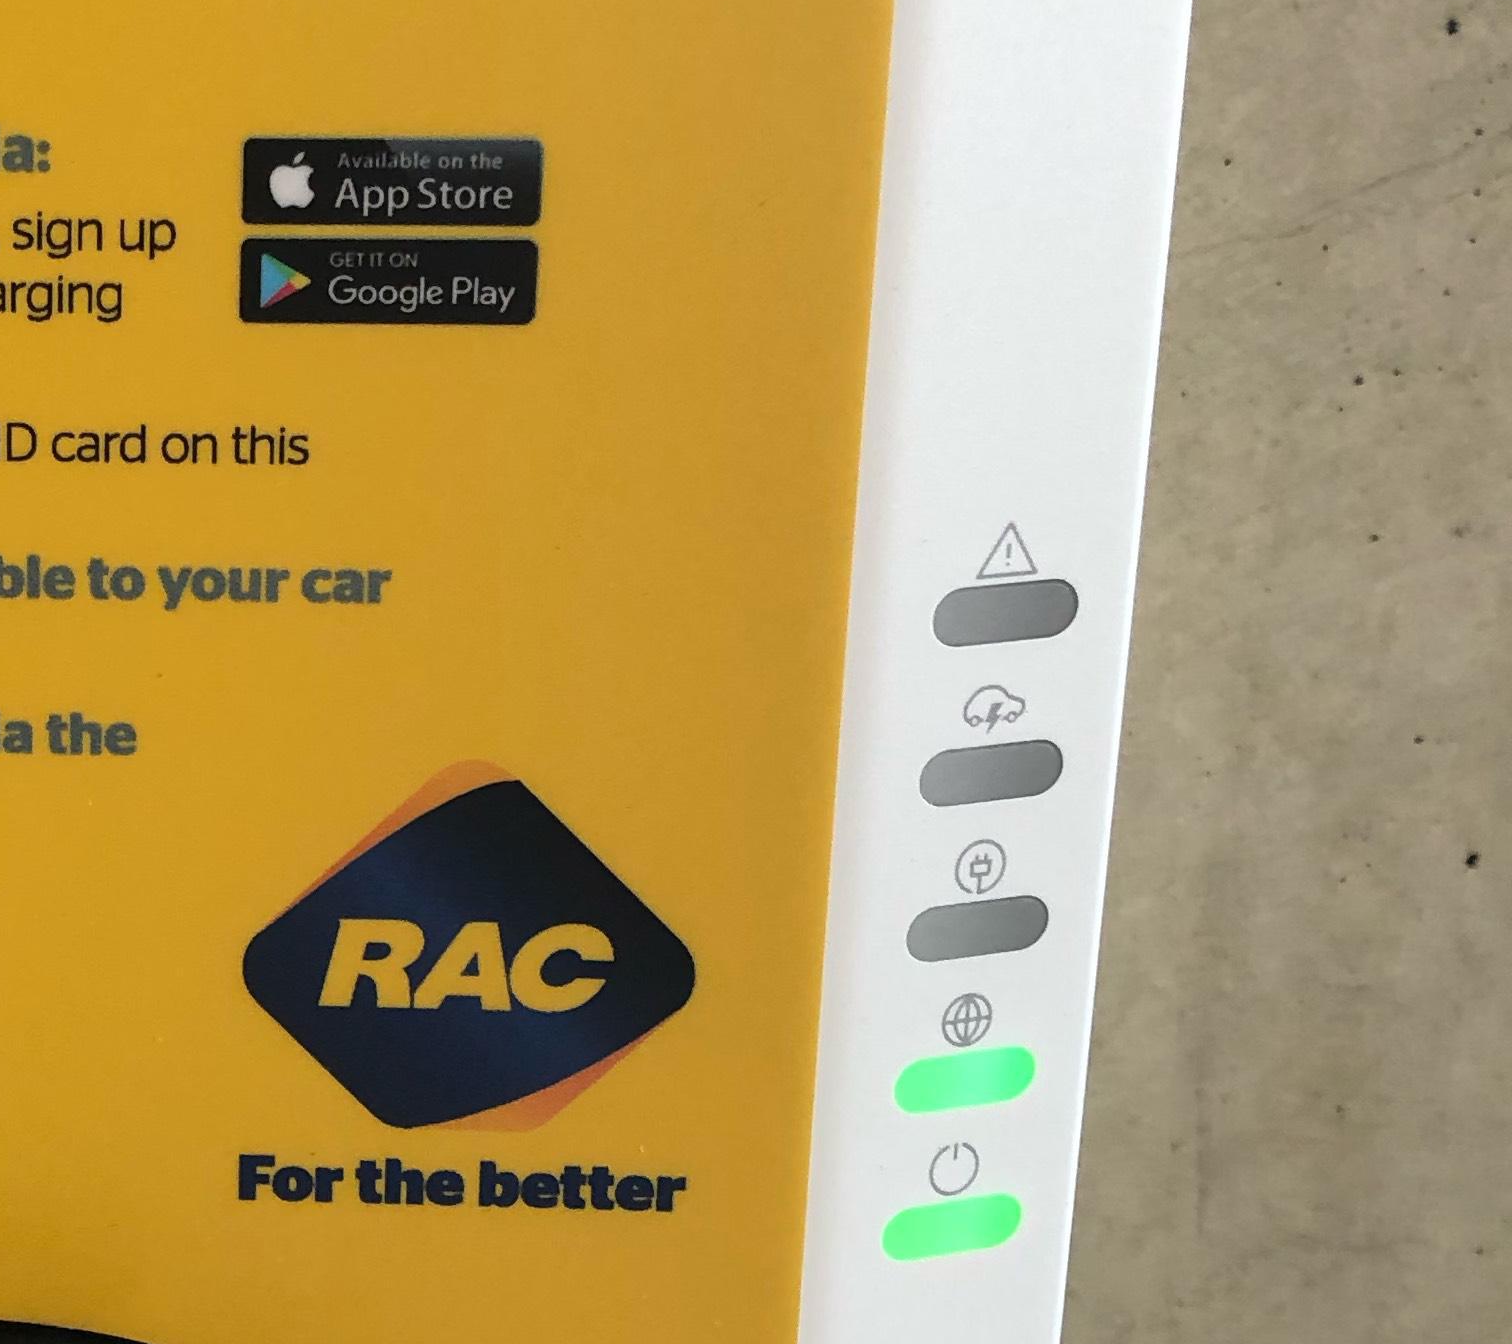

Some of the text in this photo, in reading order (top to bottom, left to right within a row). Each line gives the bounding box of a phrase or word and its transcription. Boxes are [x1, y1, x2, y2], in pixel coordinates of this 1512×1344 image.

[337, 151, 502, 170] Available on the
[335, 178, 512, 216] App Store
[13, 211, 103, 259] sign
[120, 219, 176, 260] up
[330, 252, 417, 267] GET IT ON
[328, 275, 515, 313] Google Play
[52, 424, 146, 463] card
[161, 433, 217, 464] on
[232, 425, 309, 465] this
[87, 558, 146, 600] to
[157, 566, 290, 611] your
[301, 568, 392, 604] car
[46, 712, 137, 756] the
[318, 919, 614, 1013] RAC
[238, 1154, 687, 1212] For the better
